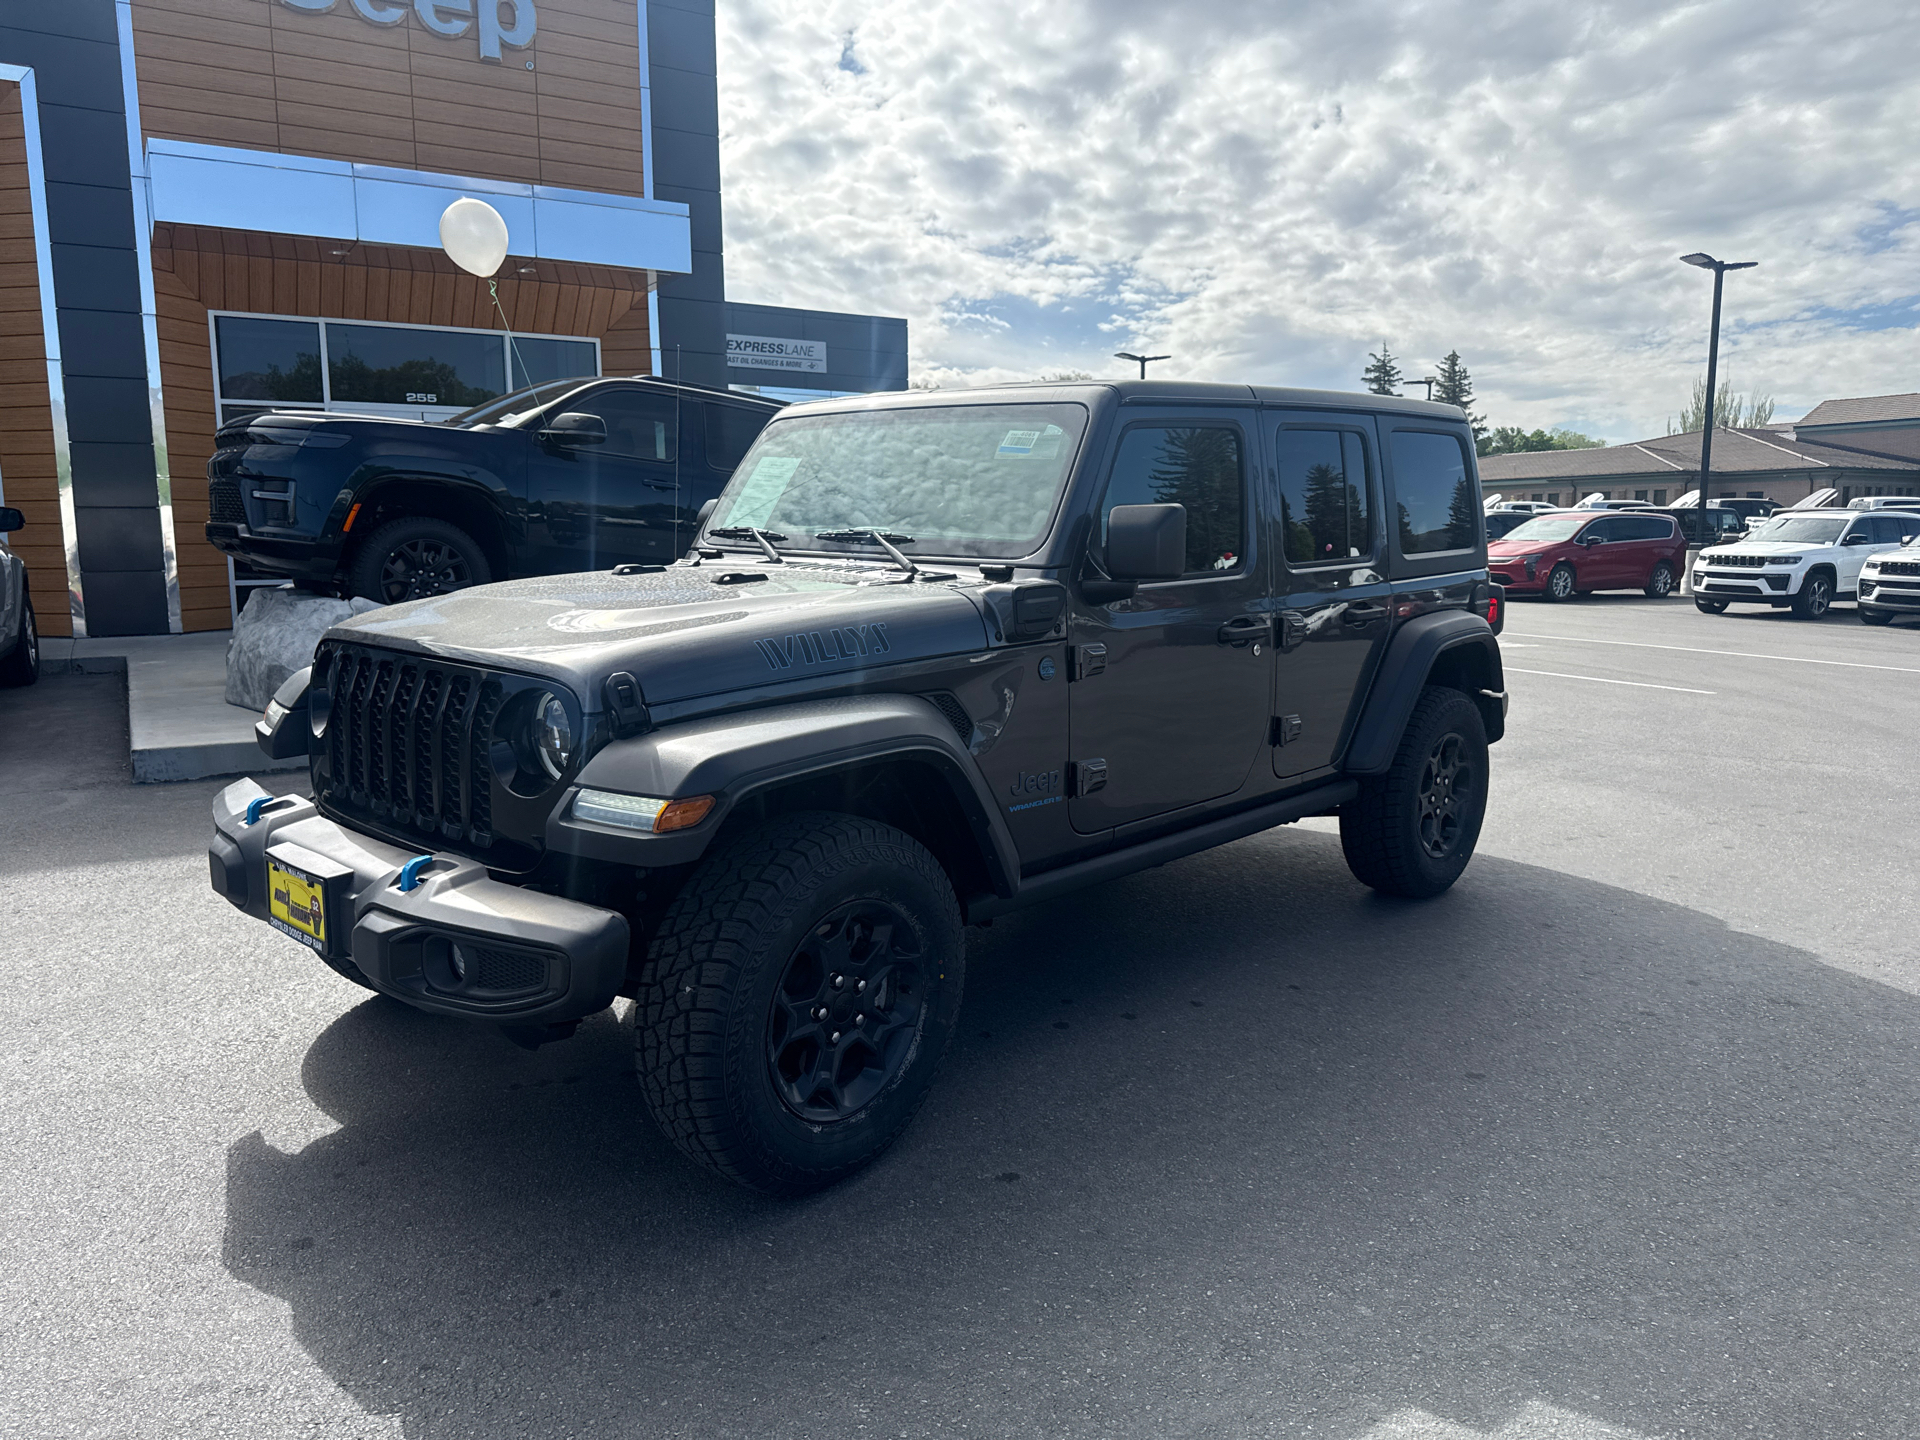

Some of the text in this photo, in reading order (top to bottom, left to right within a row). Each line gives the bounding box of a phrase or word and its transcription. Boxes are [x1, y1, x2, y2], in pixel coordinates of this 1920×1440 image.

[280, 0, 537, 64] ep
[726, 340, 815, 357] EXPRESSLANE
[727, 356, 739, 364] AST
[740, 357, 750, 365] OIL
[751, 358, 779, 367] CHANGES
[785, 360, 802, 368] MORE
[406, 392, 437, 403] 255
[753, 622, 891, 670] WILLYS
[1010, 769, 1060, 797] Jeep
[1009, 797, 1055, 812] WRANGLER
[270, 916, 323, 951] CHRYSLER DODGE JEEP RAM
